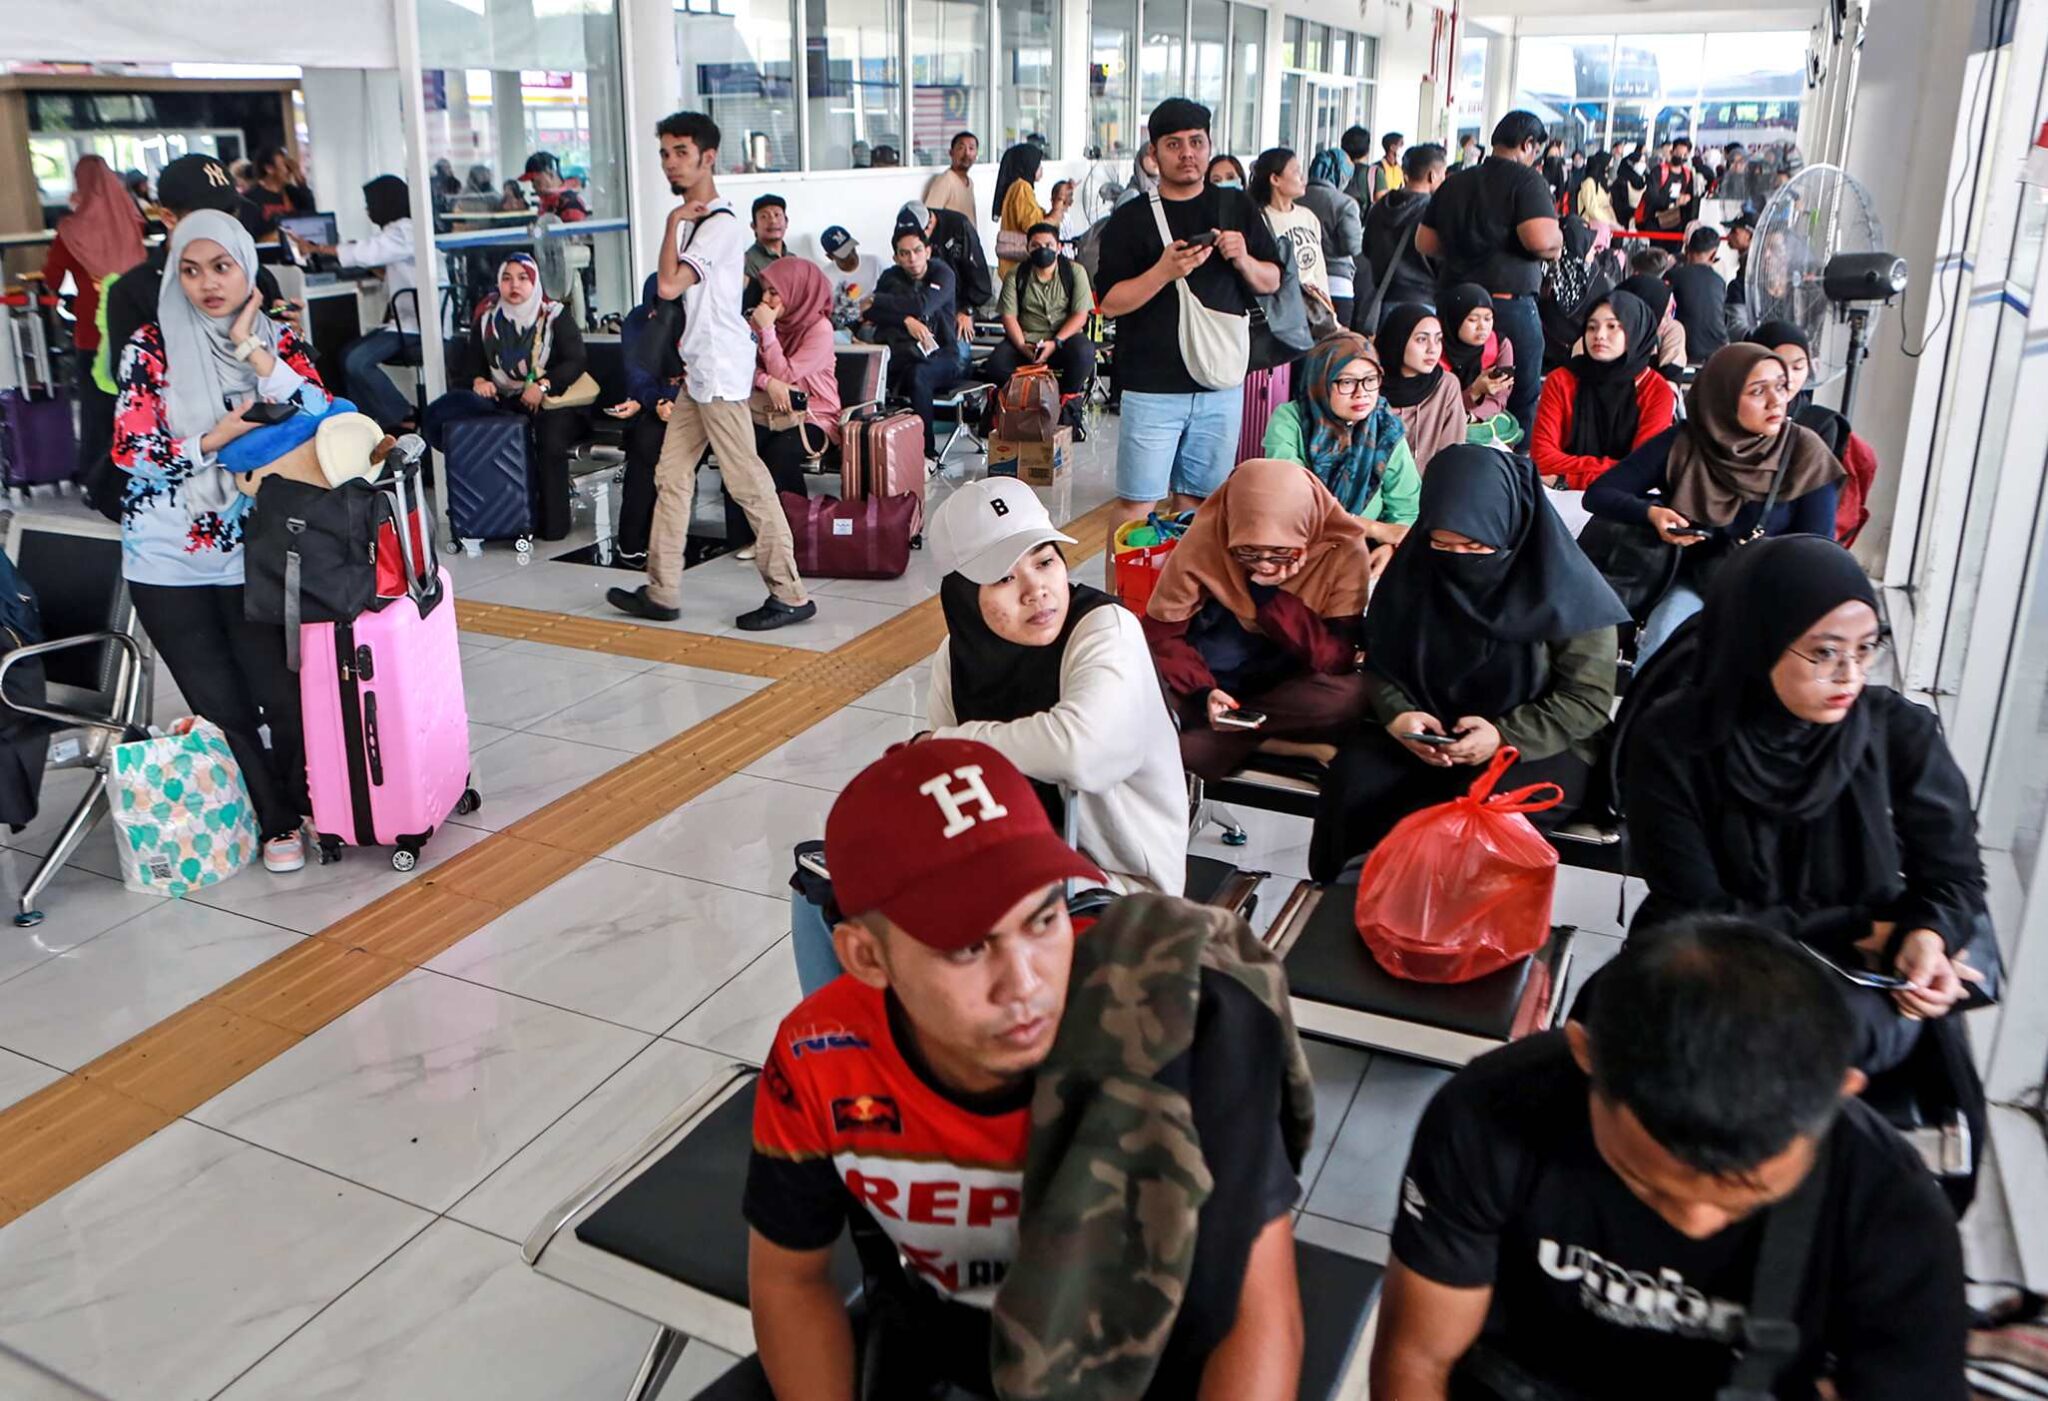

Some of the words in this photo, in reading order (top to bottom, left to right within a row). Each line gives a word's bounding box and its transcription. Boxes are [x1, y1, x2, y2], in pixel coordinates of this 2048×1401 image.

[203, 162, 230, 187] NY
[990, 498, 1010, 517] B
[919, 764, 1008, 839] H
[845, 1167, 1020, 1228] REP
